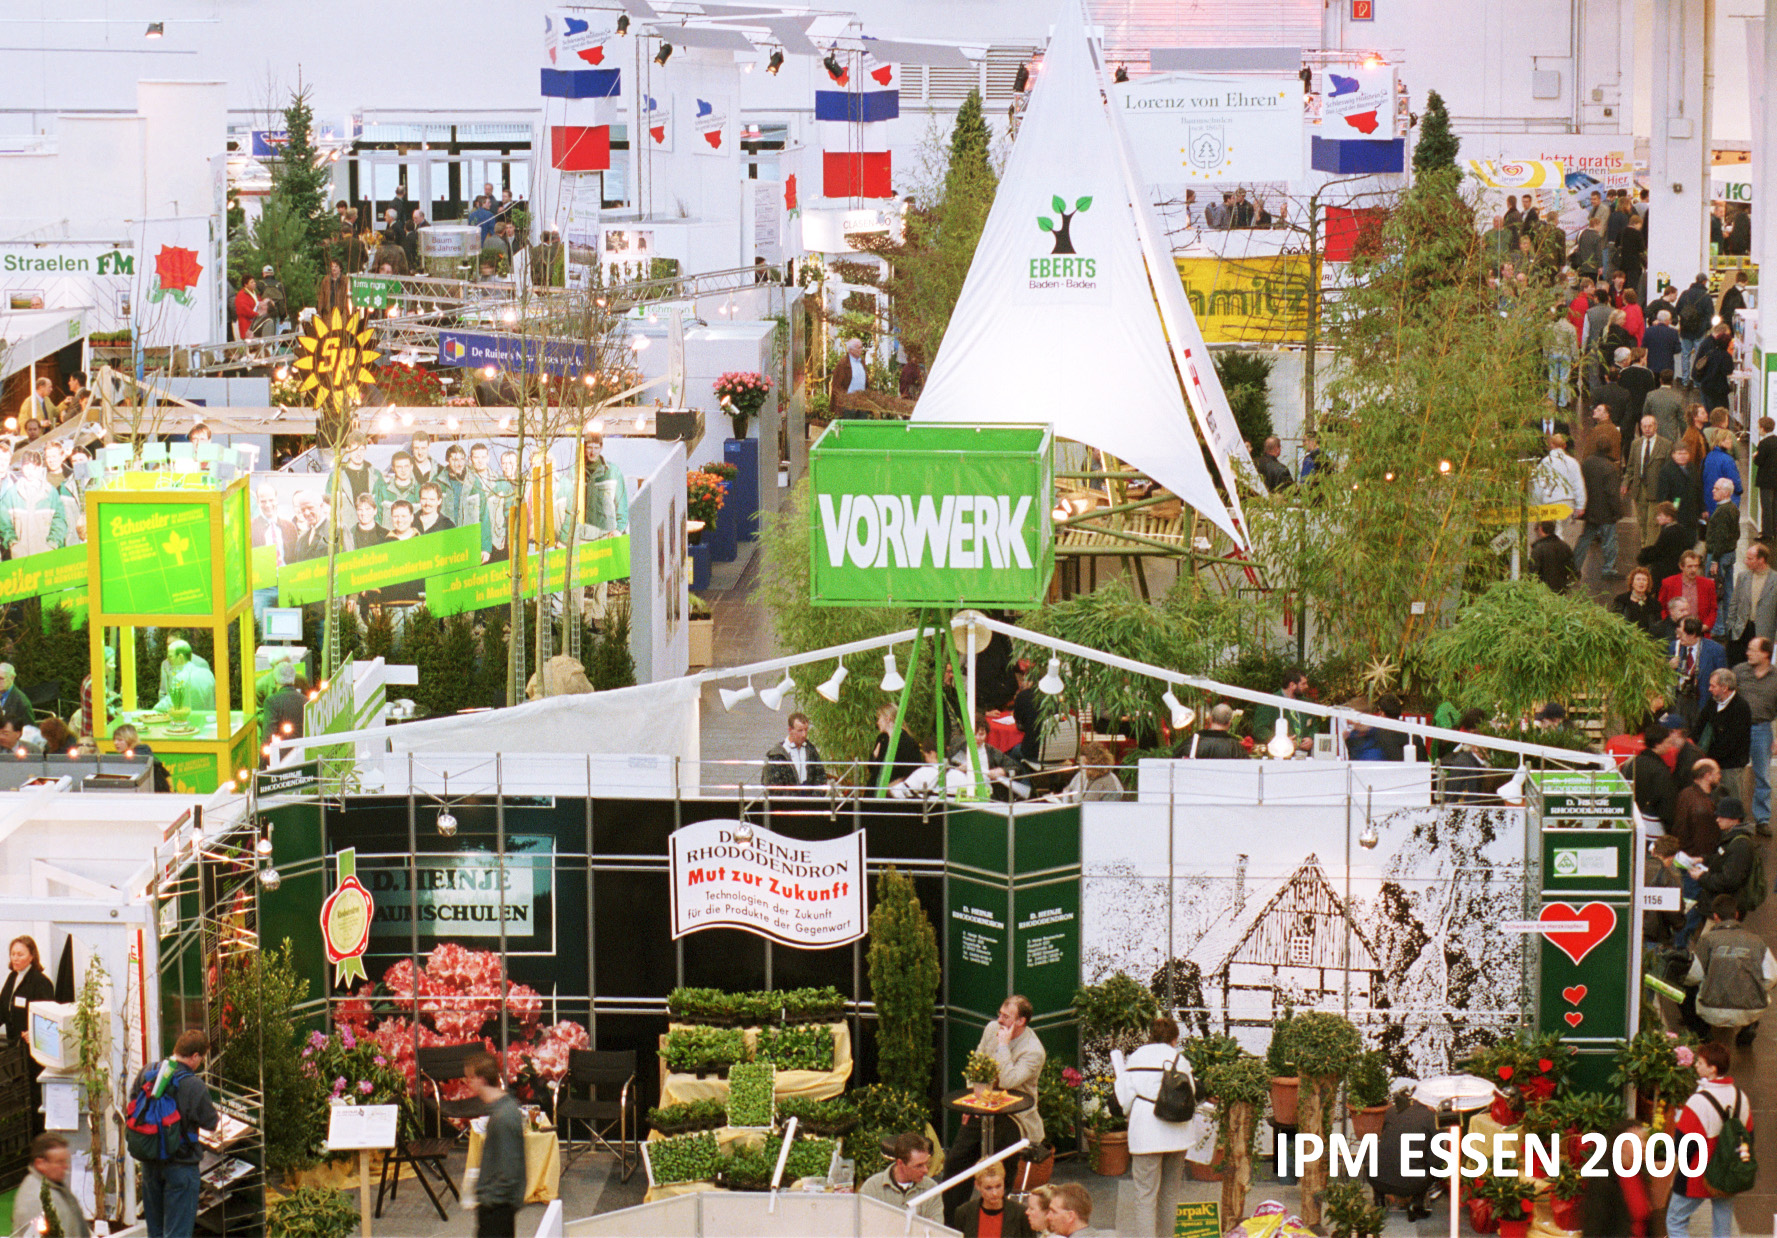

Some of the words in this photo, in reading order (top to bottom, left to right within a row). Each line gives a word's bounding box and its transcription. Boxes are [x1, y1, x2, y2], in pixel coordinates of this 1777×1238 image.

[1125, 94, 1184, 109] Lorenz
[1191, 97, 1219, 107] von
[1226, 92, 1277, 107] Ehren
[1583, 151, 1622, 172] gratis
[1607, 174, 1629, 186] Hier
[432, 236, 452, 244] Baum
[437, 244, 462, 252] Jahres
[4, 254, 89, 271] Straelen
[96, 250, 135, 275] FM
[1030, 258, 1096, 278] EBERTS
[471, 347, 483, 357] De
[818, 494, 1033, 570] VORWERK
[434, 548, 469, 568] Service!
[464, 572, 489, 589] sofort
[260, 775, 314, 794] RHODODENDRON
[1551, 807, 1625, 815] RHODODENDRON
[687, 845, 849, 879] RHODODENDRON
[372, 869, 400, 891] D.
[405, 869, 512, 891] HEINJE
[688, 867, 726, 886] Mut
[731, 870, 764, 887] zur
[769, 877, 849, 902] Zukunft
[705, 890, 769, 910] Technologien
[773, 902, 790, 917] der
[795, 908, 833, 920] Zukunft
[1643, 895, 1664, 905] 1156
[373, 904, 529, 922] AUMSCHULEN
[688, 908, 701, 920] für
[705, 904, 721, 915] die
[725, 904, 770, 923] Produkte
[774, 919, 791, 931] der
[795, 919, 852, 937] Gegenwart
[952, 910, 1005, 930] RHODODENDRON
[1018, 912, 1074, 930] RHODODENDRON
